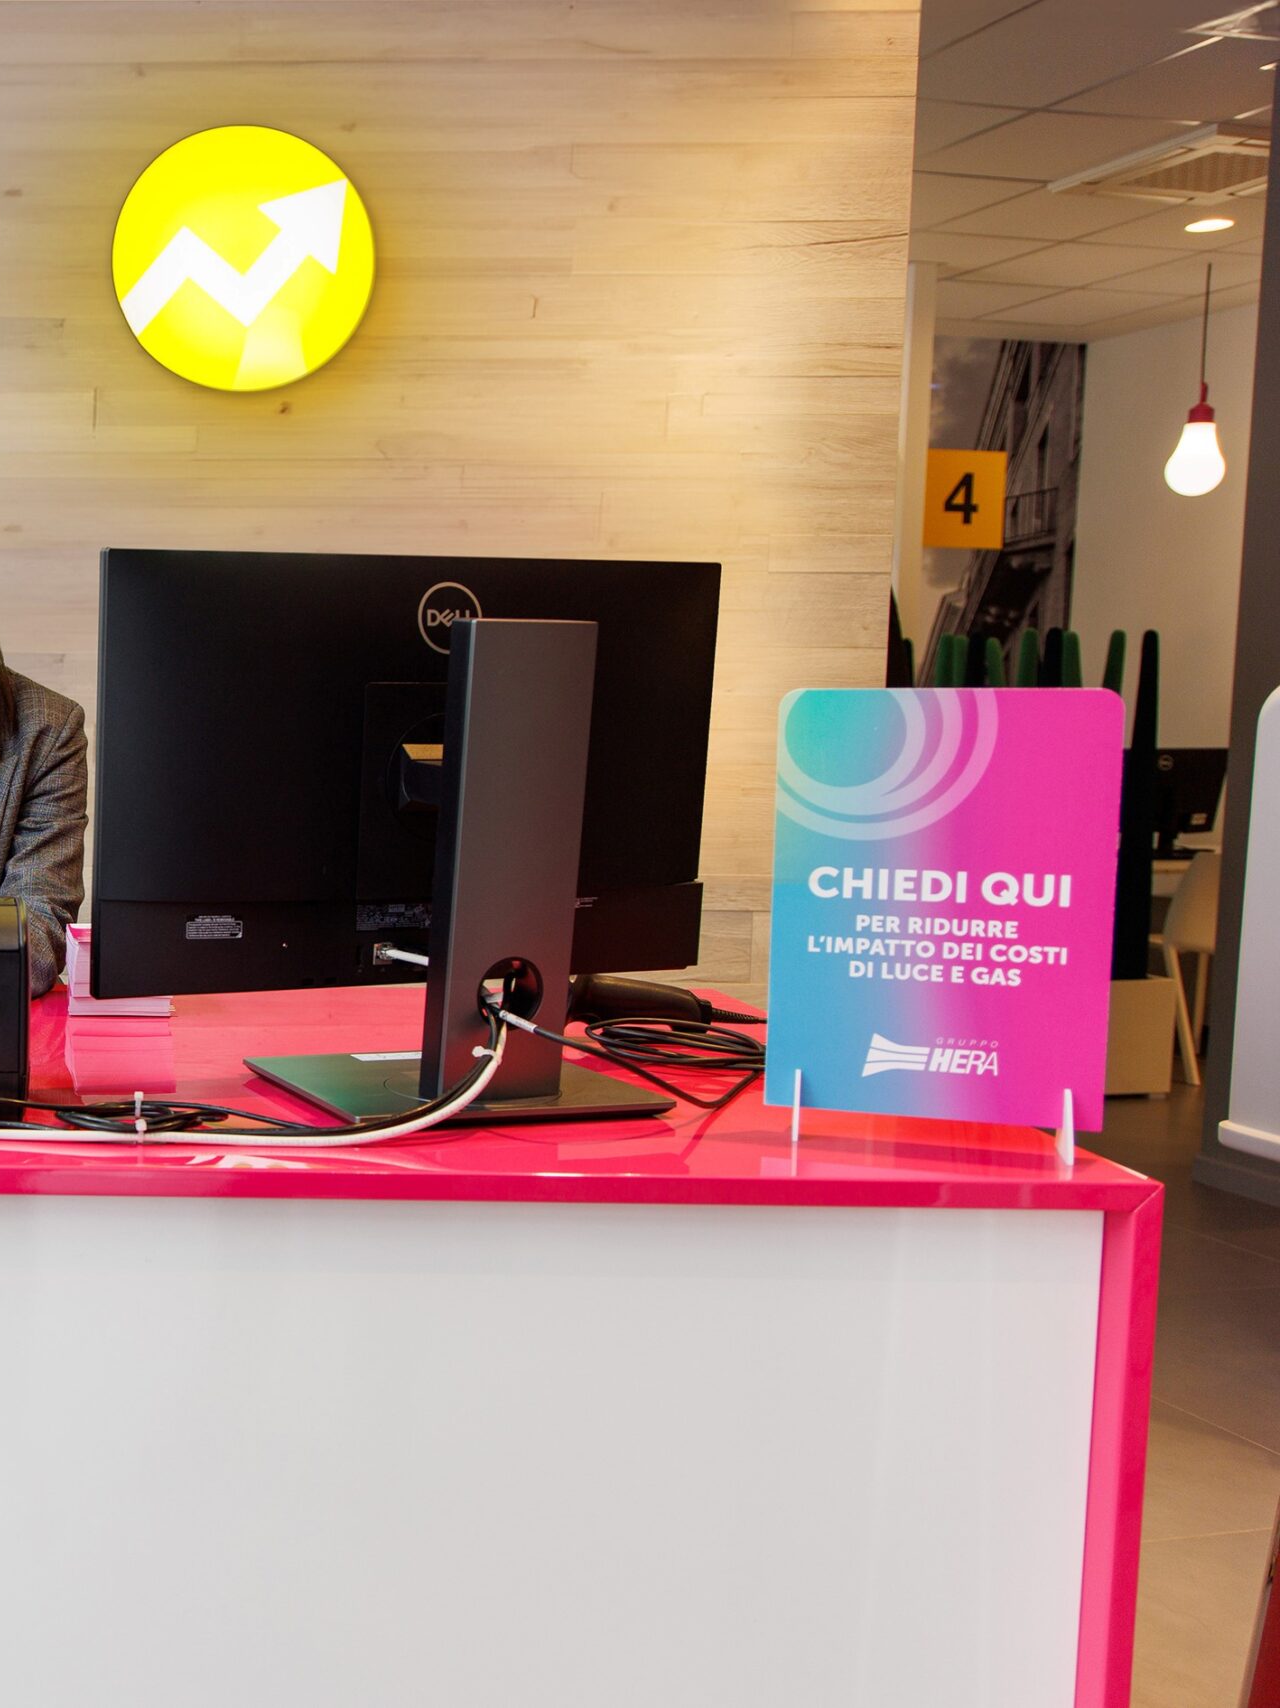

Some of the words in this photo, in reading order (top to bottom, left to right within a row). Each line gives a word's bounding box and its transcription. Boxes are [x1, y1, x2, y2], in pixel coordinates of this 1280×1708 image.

[944, 472, 978, 525] 4
[808, 866, 967, 903] CHIEDI
[981, 872, 1071, 907] QUI
[856, 914, 900, 933] PER
[907, 917, 1018, 939] RIDURRE
[807, 935, 935, 958] L'IMPATTO
[942, 942, 982, 960] DEI
[990, 944, 1067, 965] COSTI
[849, 960, 874, 978] DI
[881, 962, 943, 982] LUCE
[951, 966, 964, 984] E
[971, 967, 1021, 986] GAS
[936, 1037, 998, 1048] GRUPPO
[928, 1048, 998, 1076] HERA
